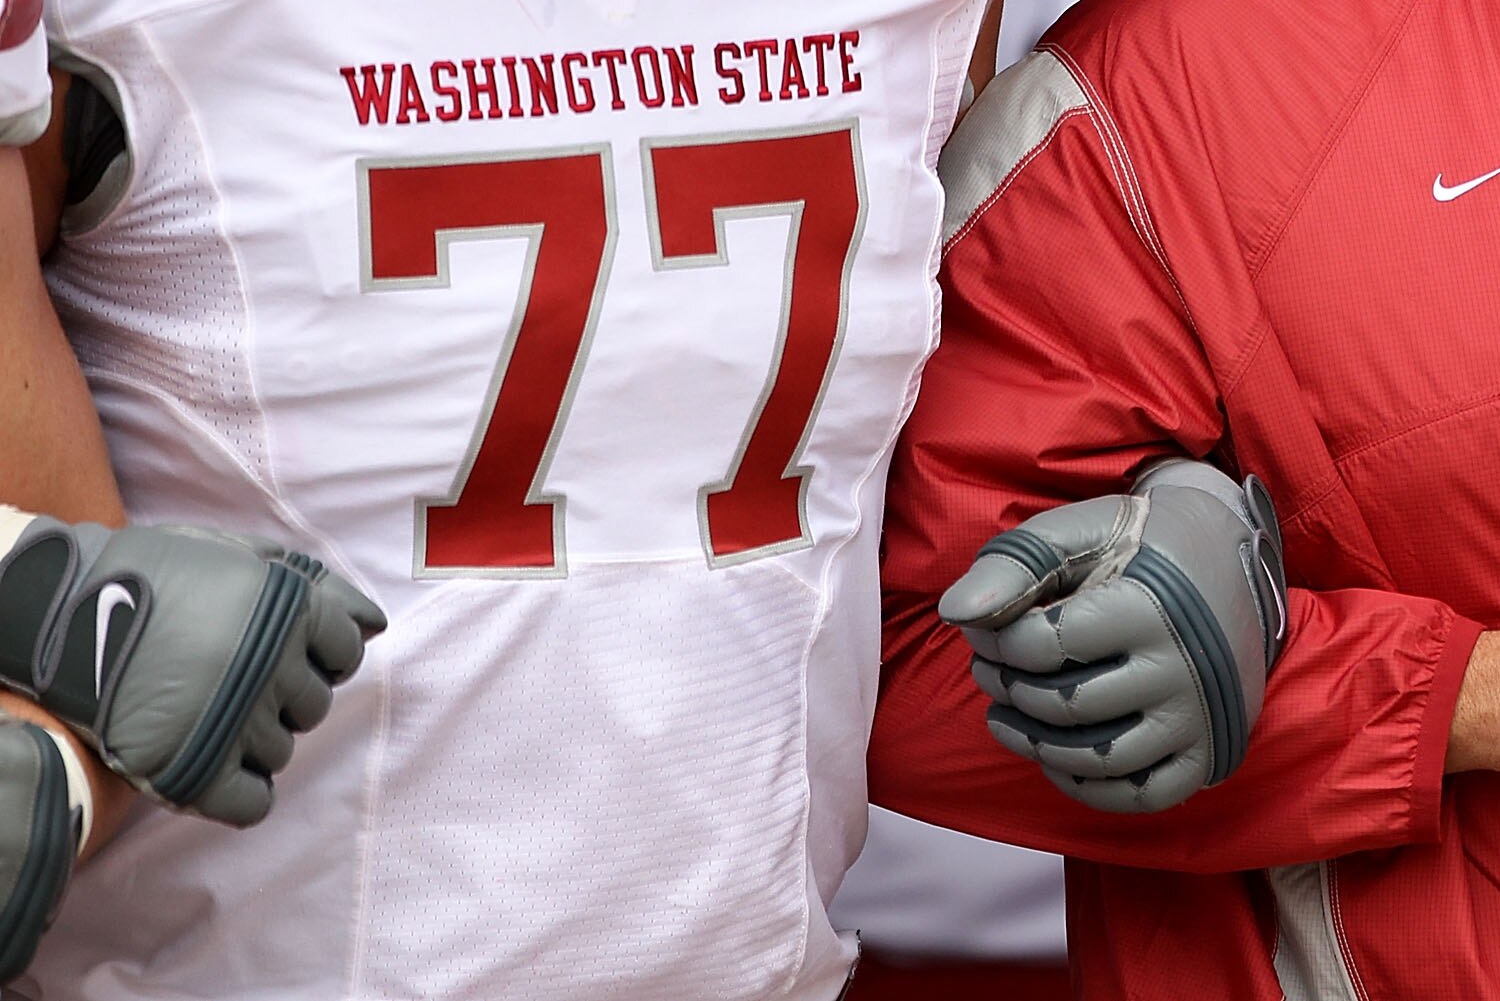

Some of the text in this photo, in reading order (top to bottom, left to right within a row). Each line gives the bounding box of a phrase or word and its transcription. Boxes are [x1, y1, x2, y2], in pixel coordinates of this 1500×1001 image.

[340, 30, 863, 125] WASHINGTON STATE
[356, 117, 869, 580] 77
